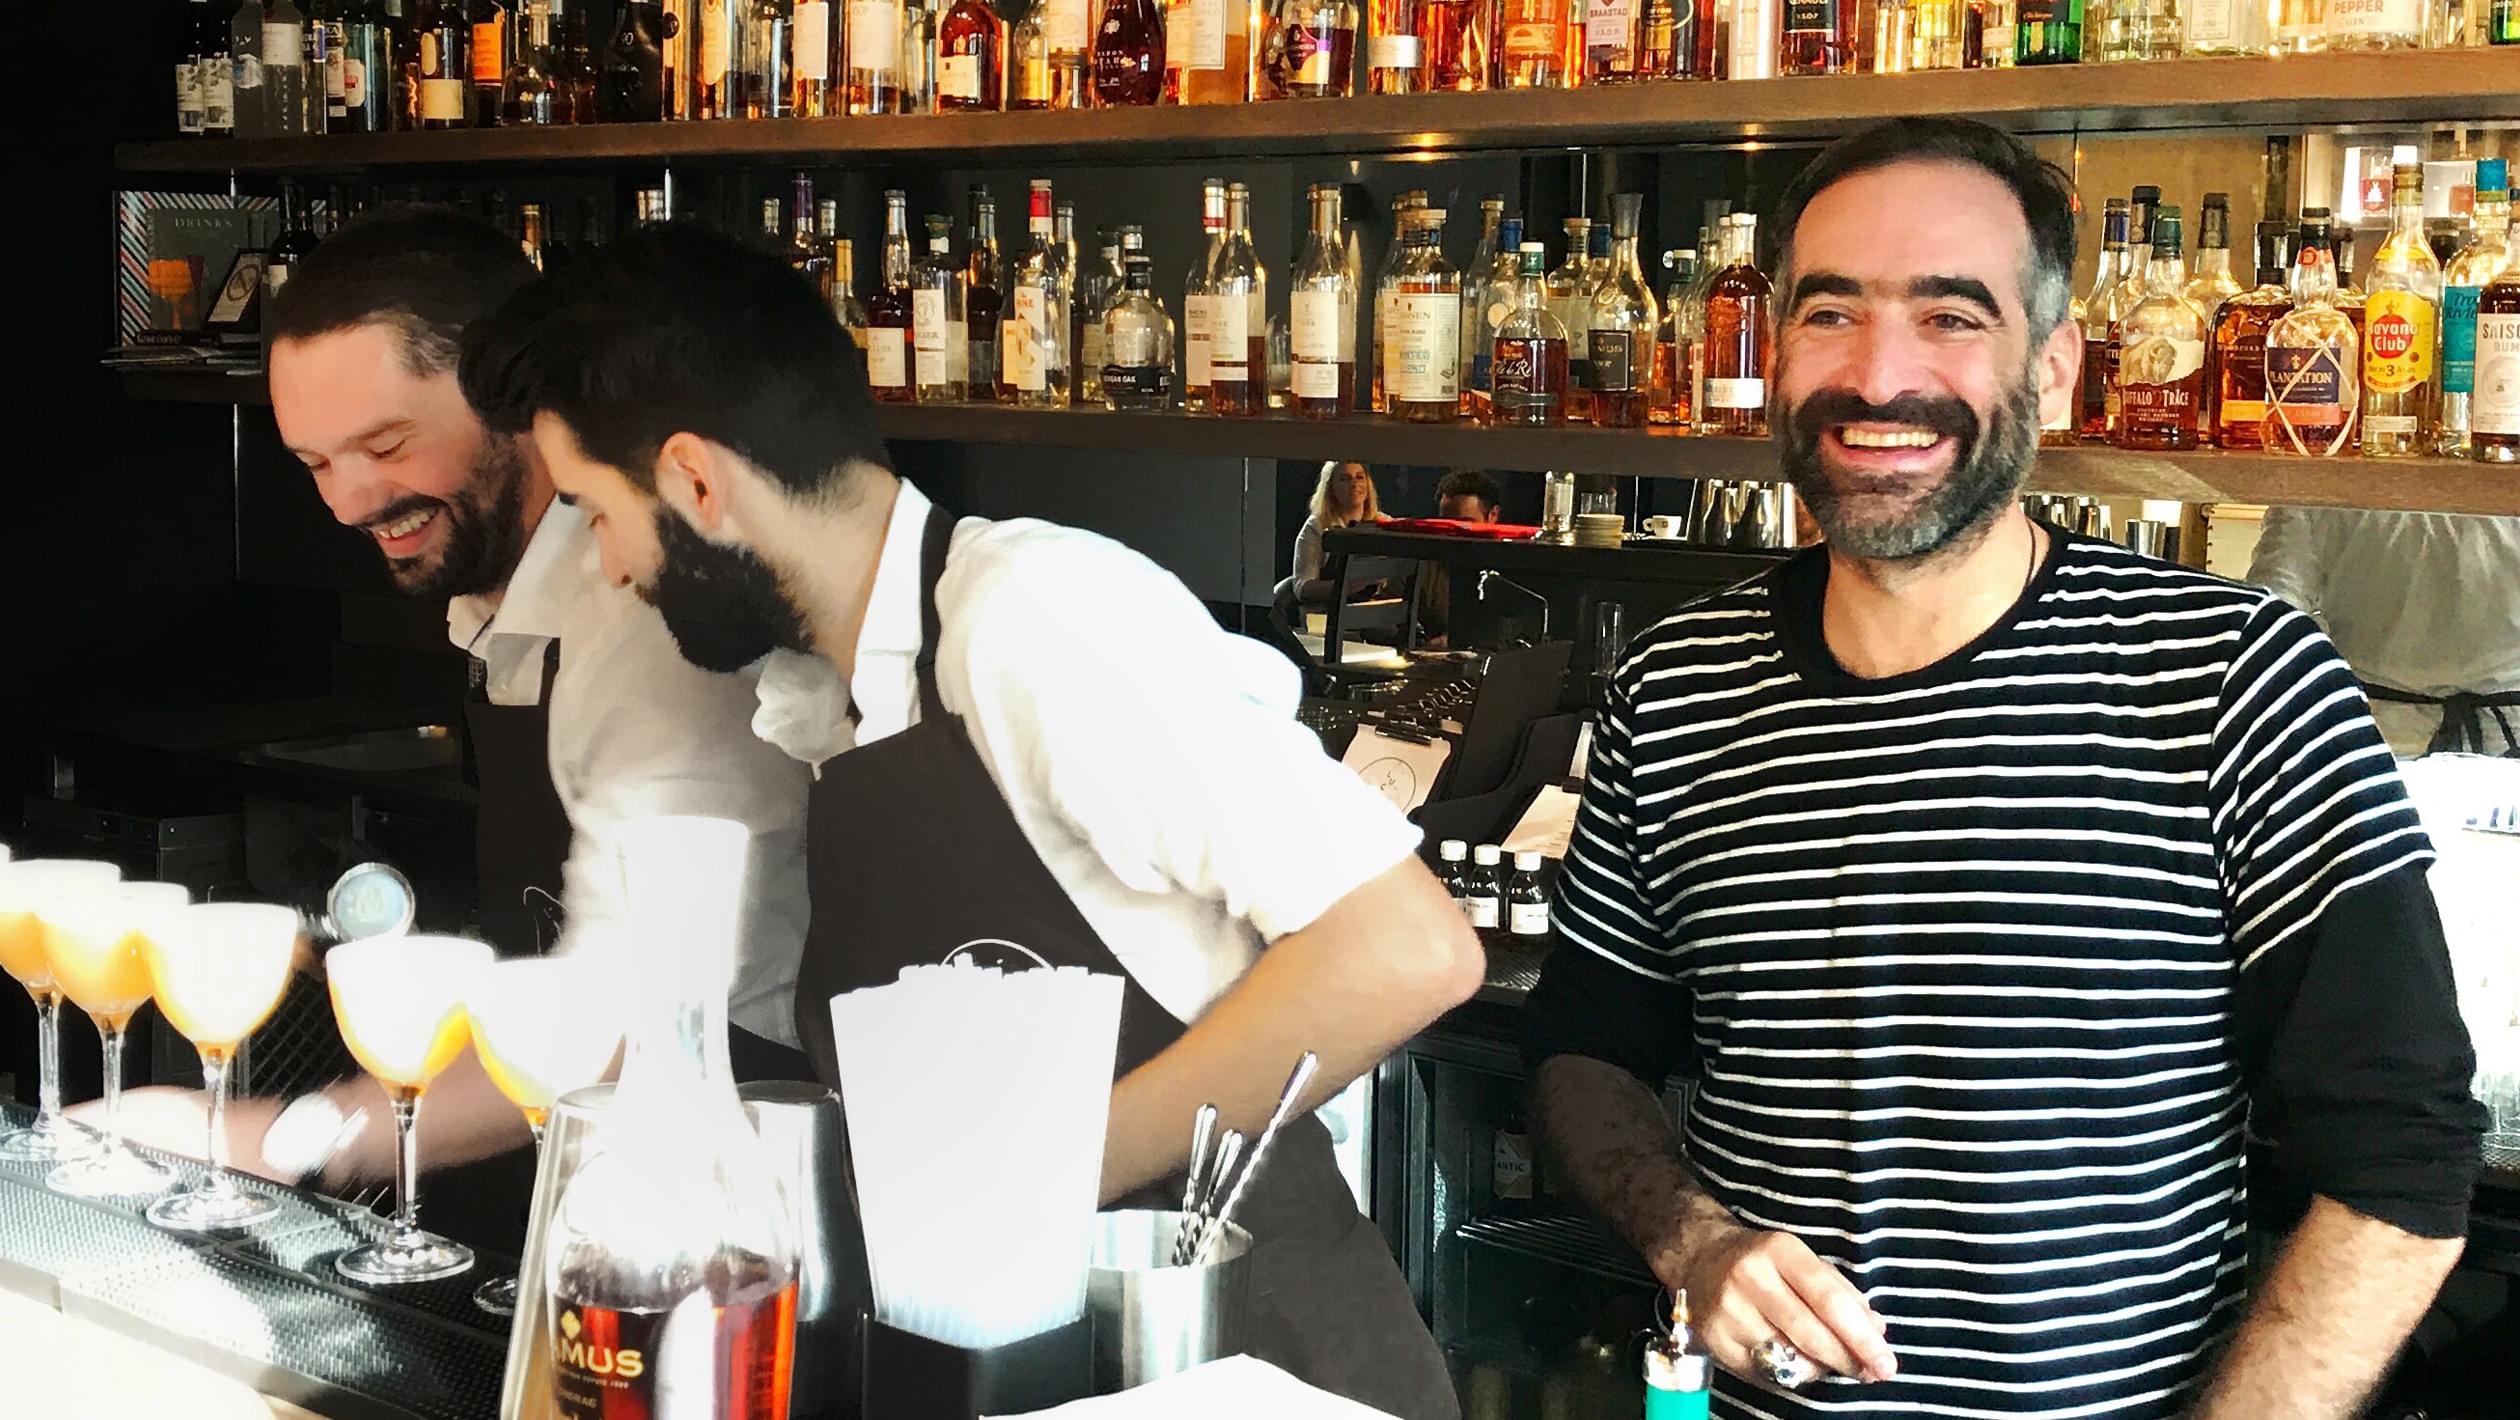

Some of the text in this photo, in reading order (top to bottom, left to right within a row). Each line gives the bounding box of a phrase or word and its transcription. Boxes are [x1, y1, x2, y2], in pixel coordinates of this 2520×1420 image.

[1590, 8, 1628, 17] BRAASTAD
[2335, 0, 2384, 15] PEPPER
[174, 217, 233, 228] DRINKS
[2374, 336, 2406, 351] Club
[2386, 365, 2395, 377] 3
[2162, 388, 2189, 407] TRACE
